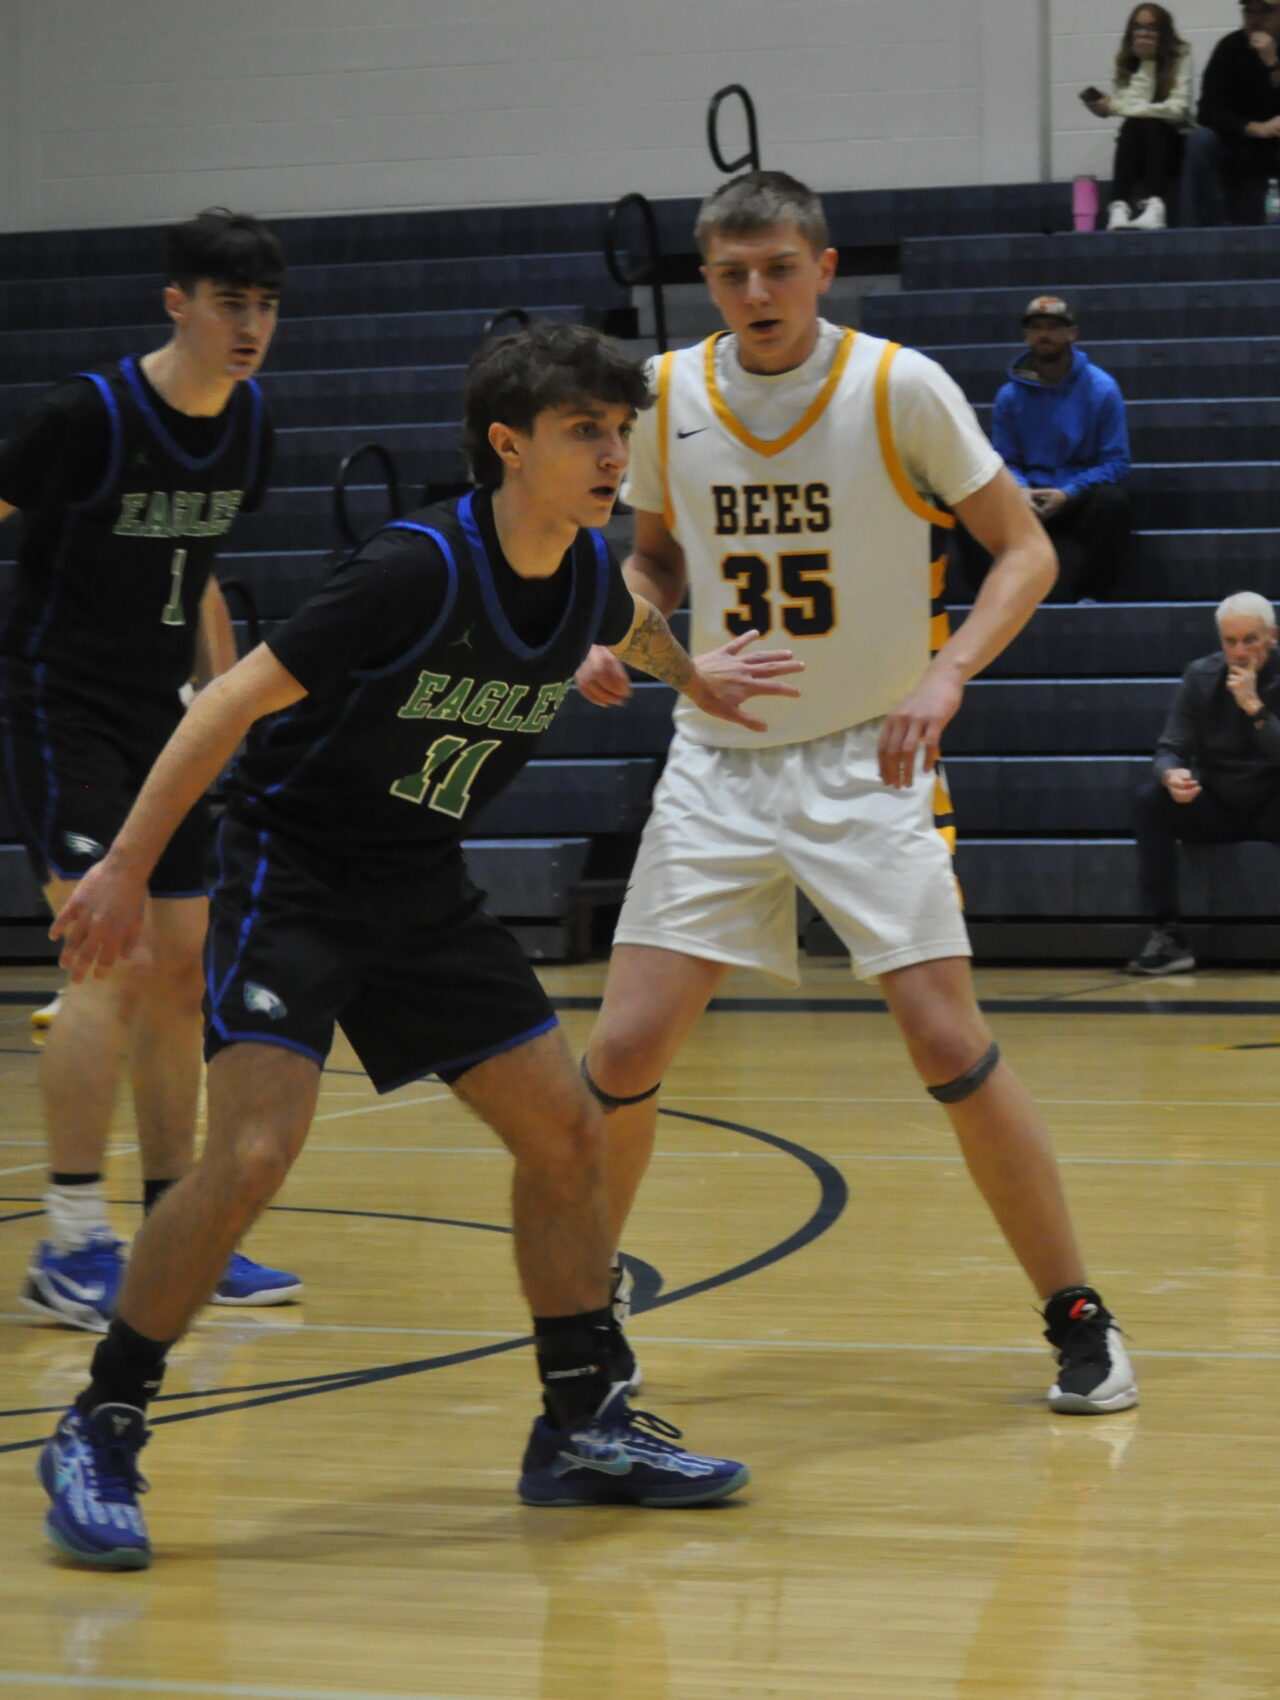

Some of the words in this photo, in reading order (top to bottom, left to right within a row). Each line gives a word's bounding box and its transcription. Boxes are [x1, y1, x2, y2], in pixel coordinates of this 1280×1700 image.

[711, 482, 831, 536] BEES
[161, 548, 188, 625] 1
[720, 550, 837, 640] 35
[389, 735, 502, 820] 11
